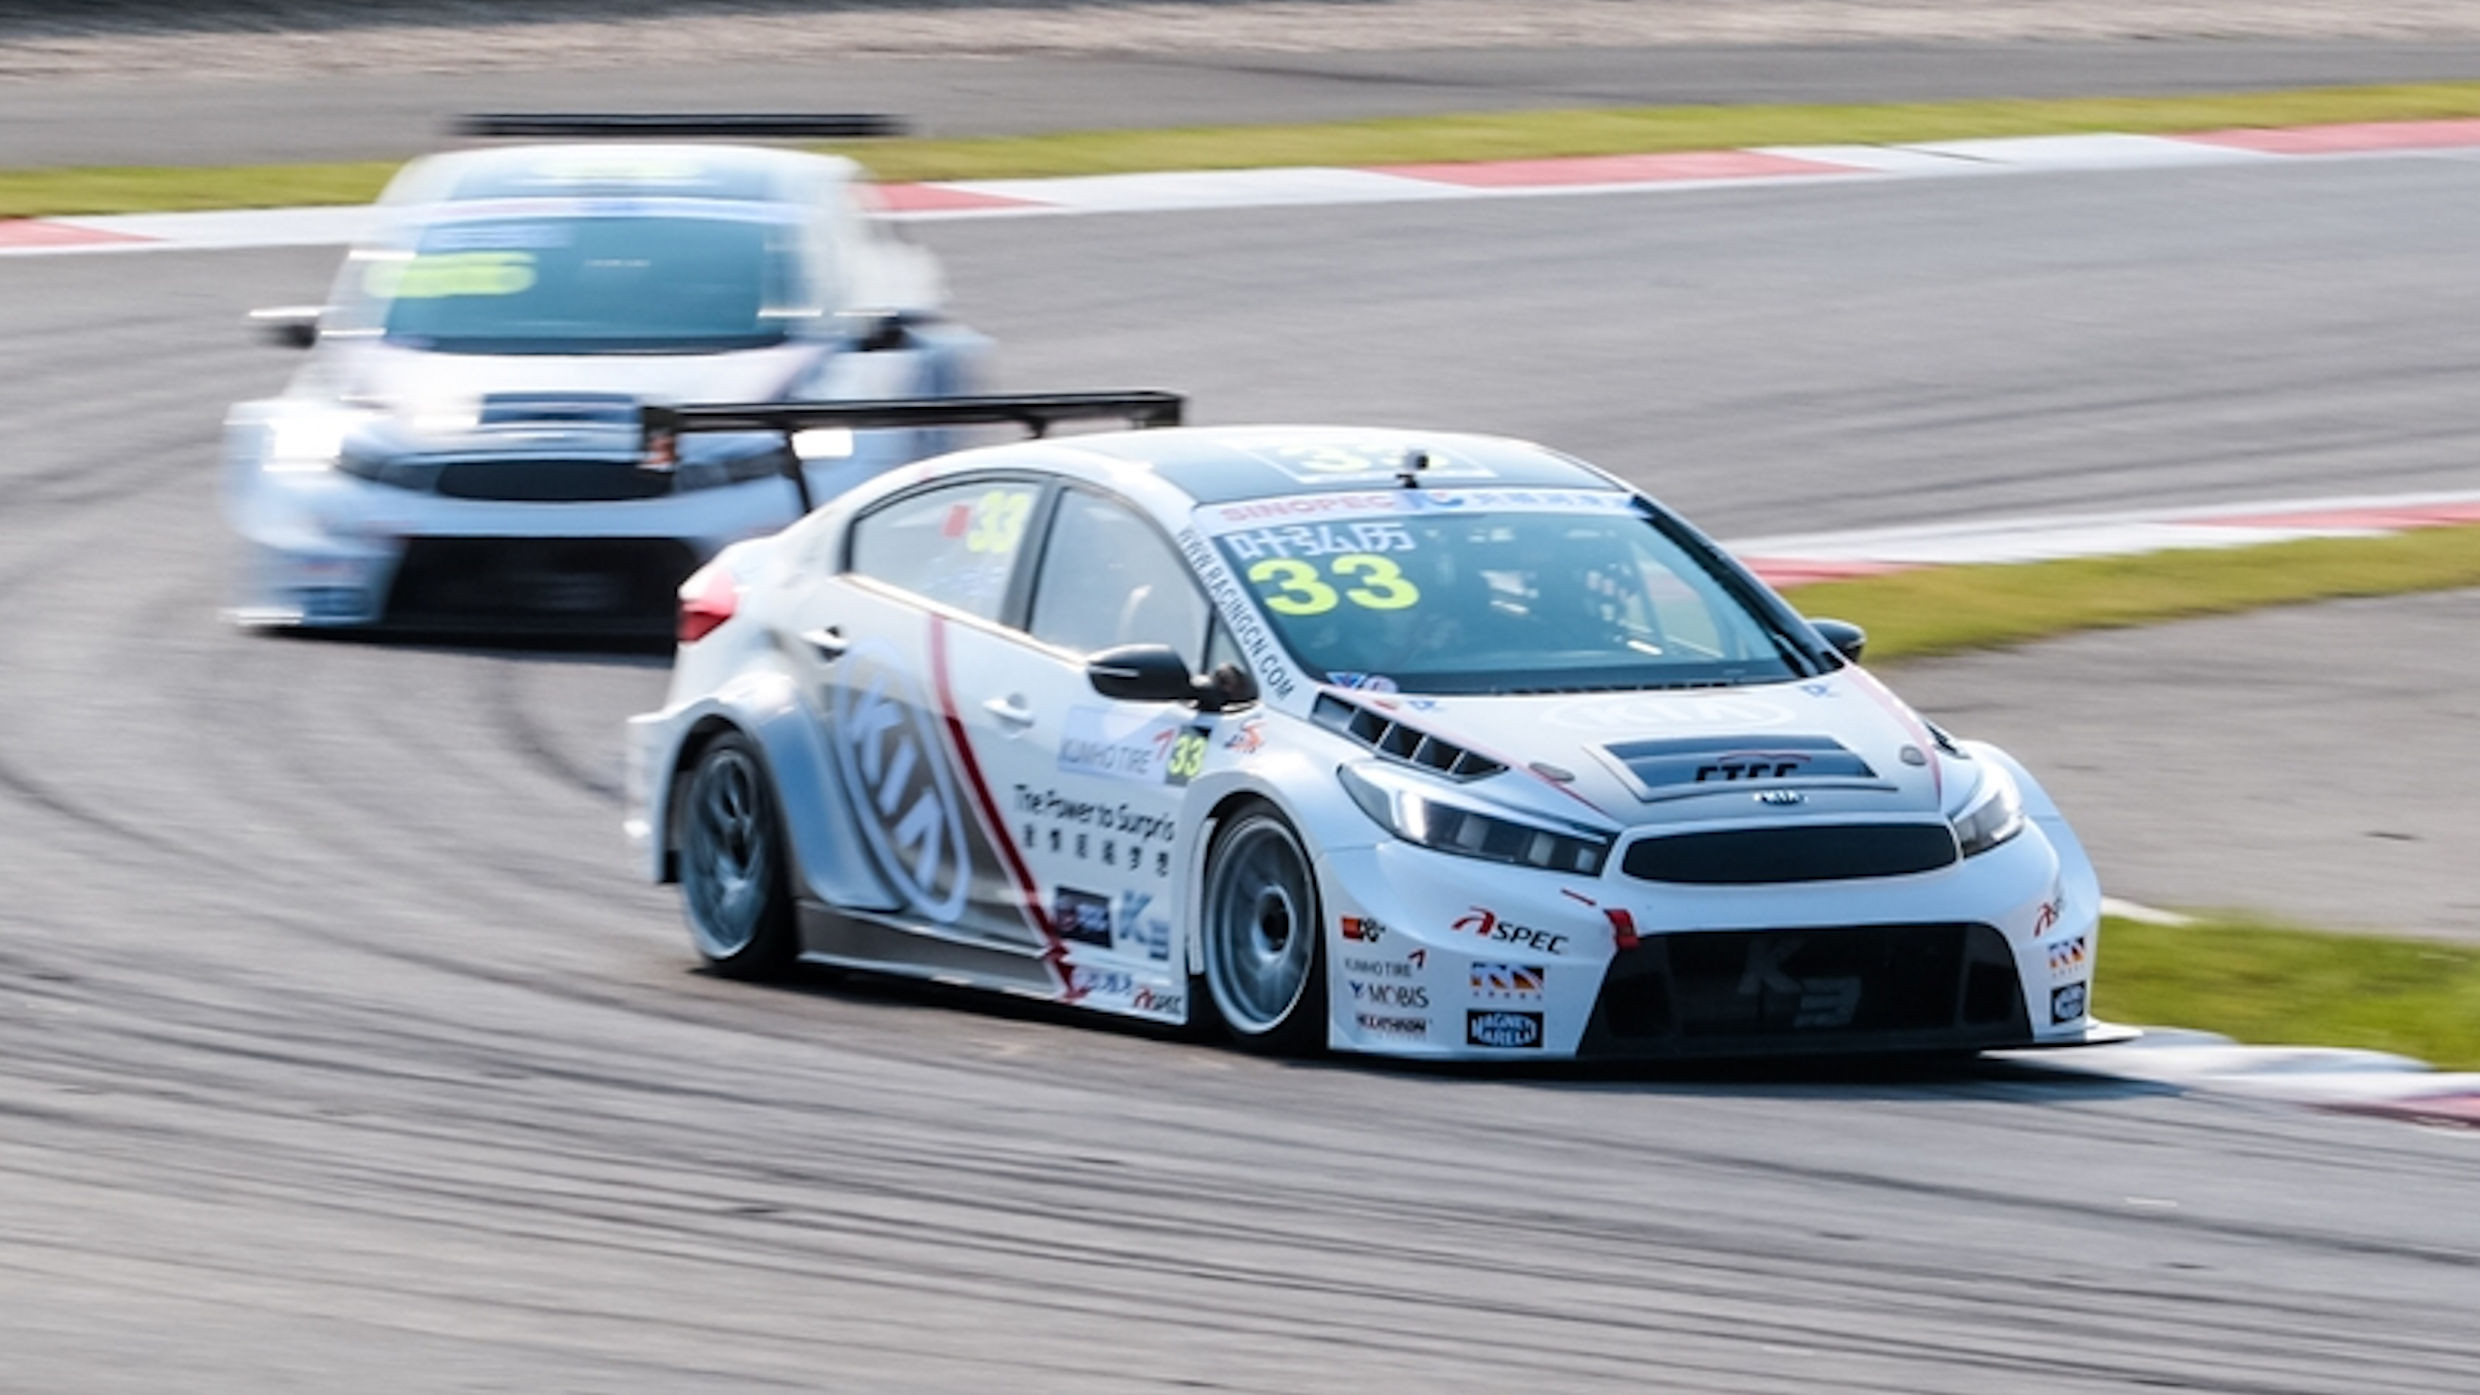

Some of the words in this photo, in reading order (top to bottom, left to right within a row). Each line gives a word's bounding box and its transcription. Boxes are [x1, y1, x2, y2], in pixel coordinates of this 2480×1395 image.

[967, 490, 1031, 553] 33
[1219, 494, 1397, 523] SINOPEC
[1247, 553, 1420, 616] 33
[1168, 734, 1208, 776] 33
[850, 673, 943, 892] KIA
[1014, 783, 1043, 815] The
[1045, 789, 1095, 823] Power
[1097, 803, 1114, 828] to
[1367, 983, 1430, 1009] MOBIS
